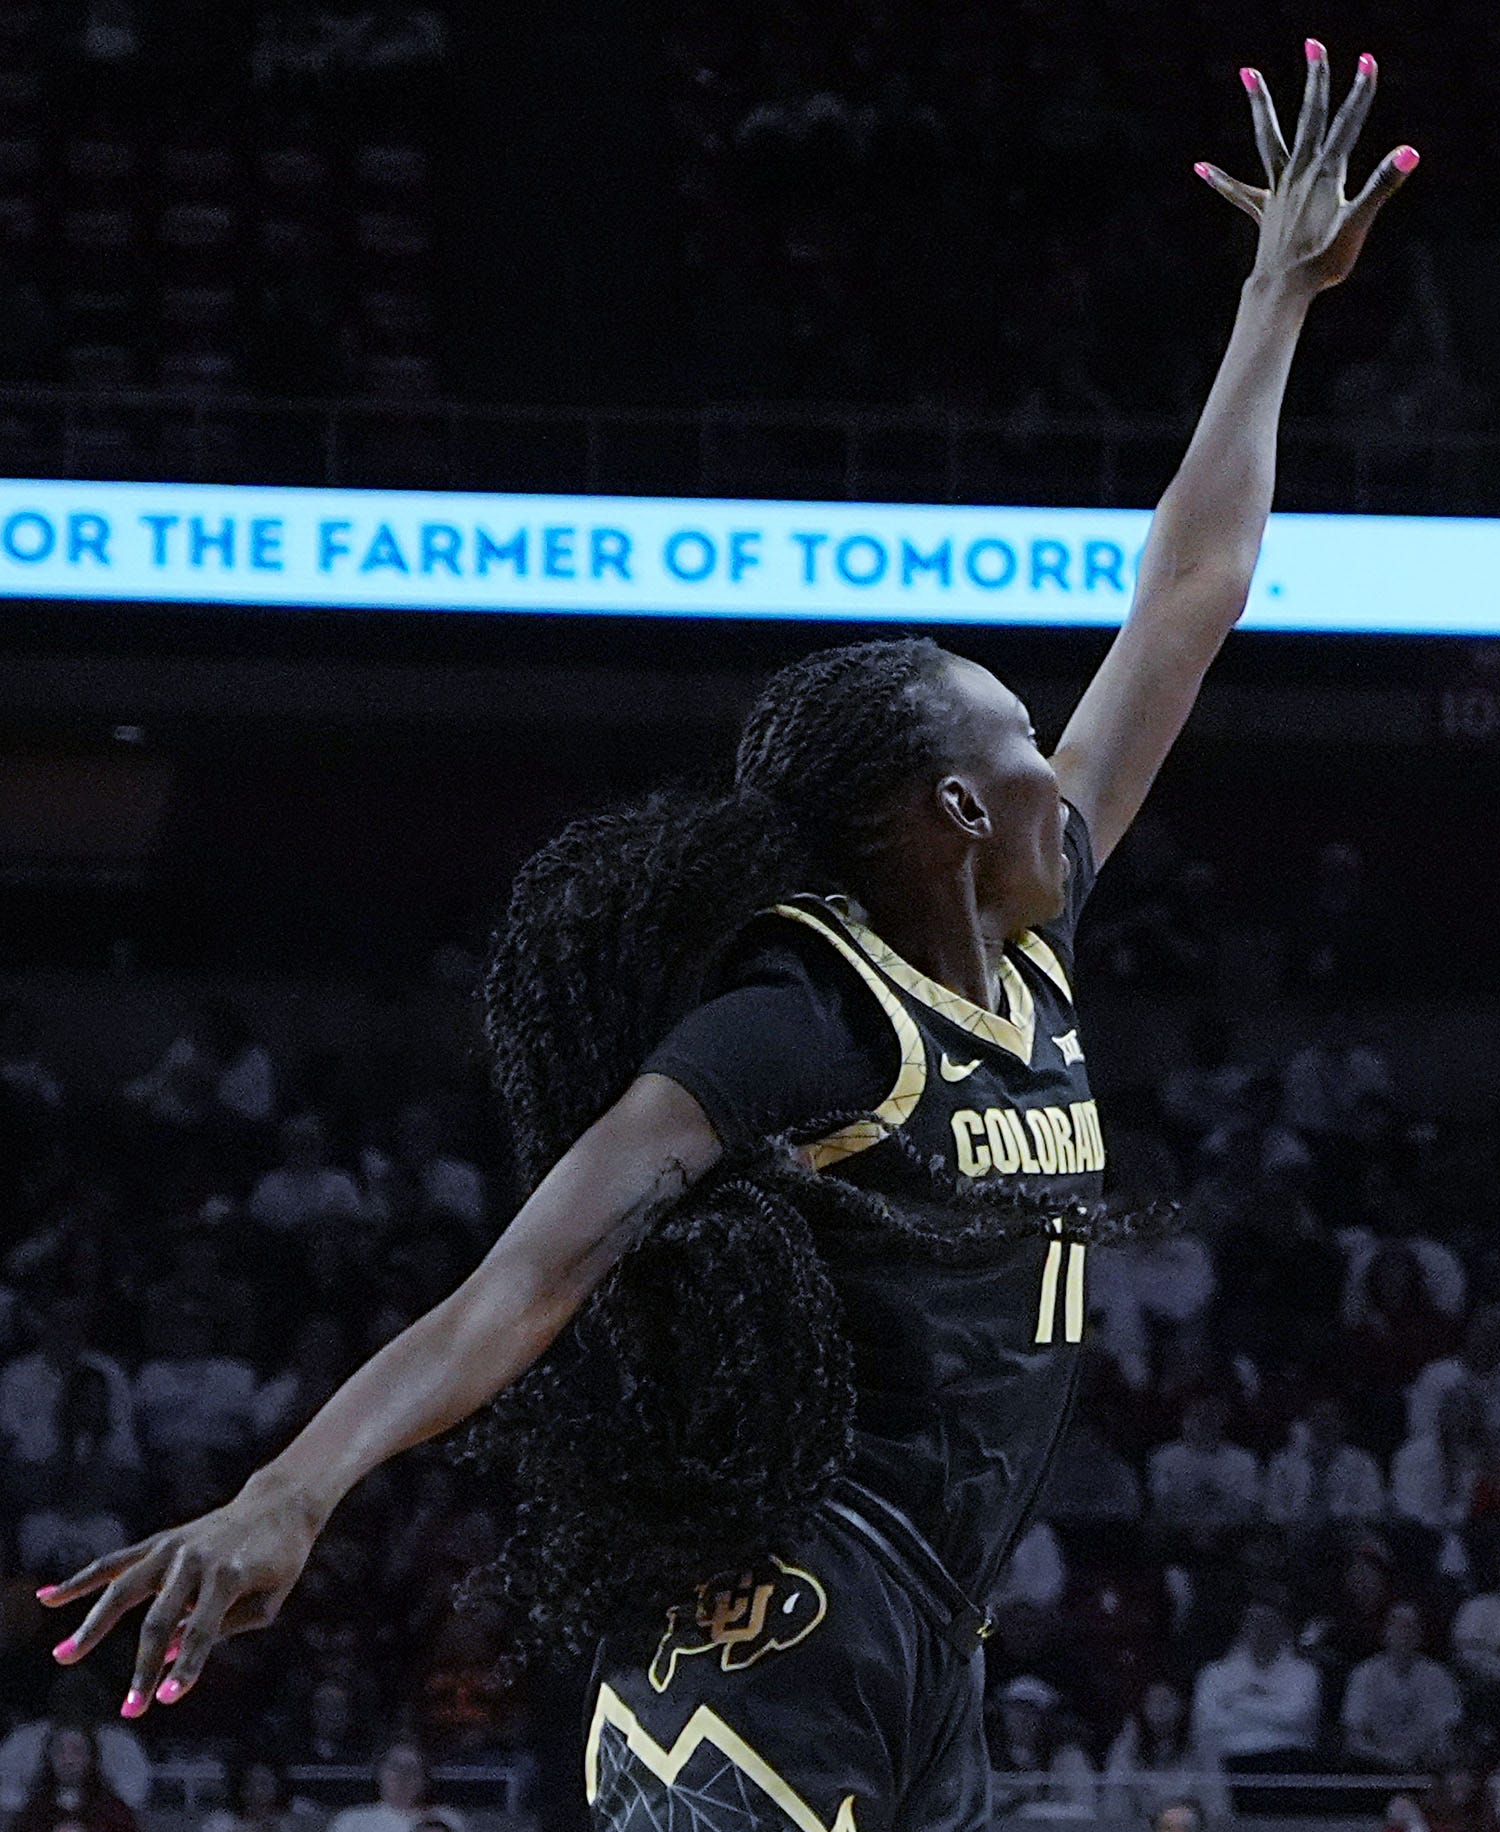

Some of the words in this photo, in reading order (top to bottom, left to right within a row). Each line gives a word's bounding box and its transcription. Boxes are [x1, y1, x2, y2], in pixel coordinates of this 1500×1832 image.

[138, 513, 284, 572] THE
[318, 520, 634, 580] FARMER
[663, 529, 762, 584] OF
[792, 532, 1285, 597] TOMORR.
[1034, 1217, 1086, 1344] 11
